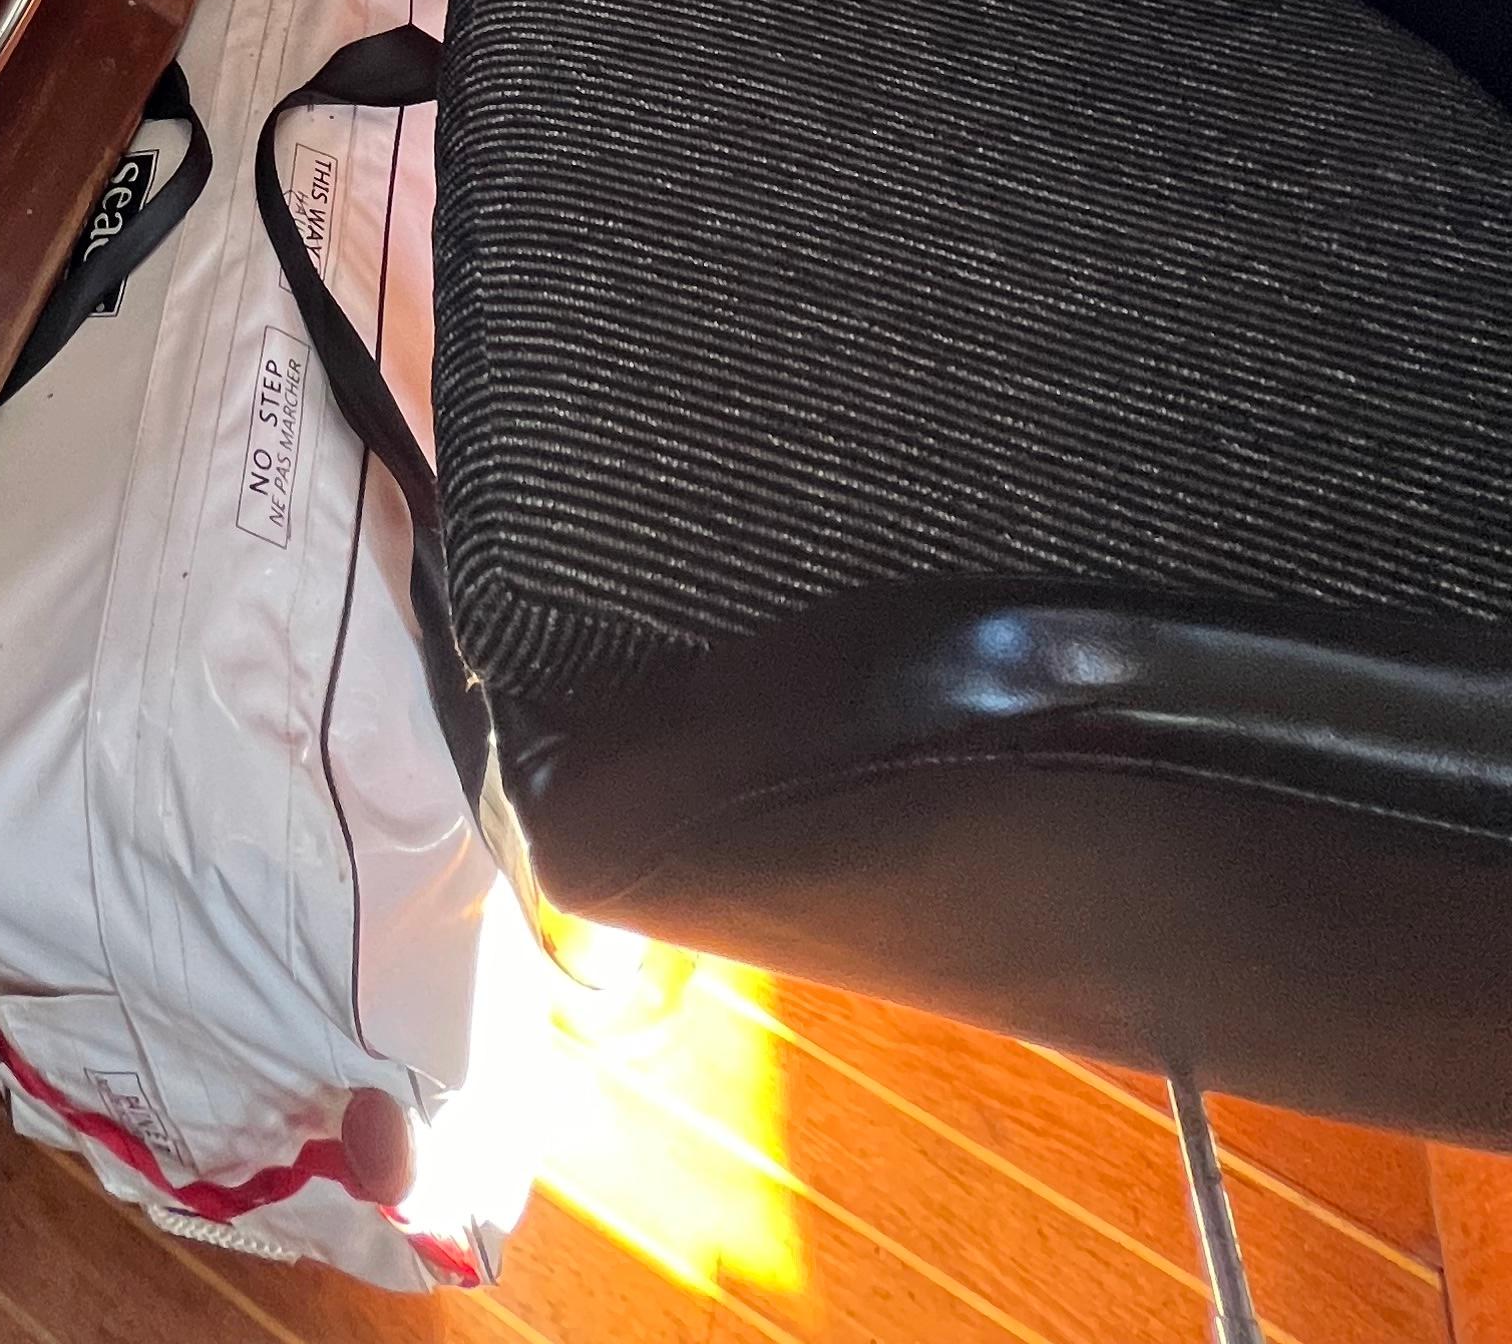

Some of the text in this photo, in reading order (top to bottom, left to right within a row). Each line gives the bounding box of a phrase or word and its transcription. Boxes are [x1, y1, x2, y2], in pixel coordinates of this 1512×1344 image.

[83, 160, 140, 263] sea
[304, 159, 332, 261] THIS WAY
[249, 358, 283, 496] NO STEP
[268, 358, 303, 528] NE PAS MARCHER
